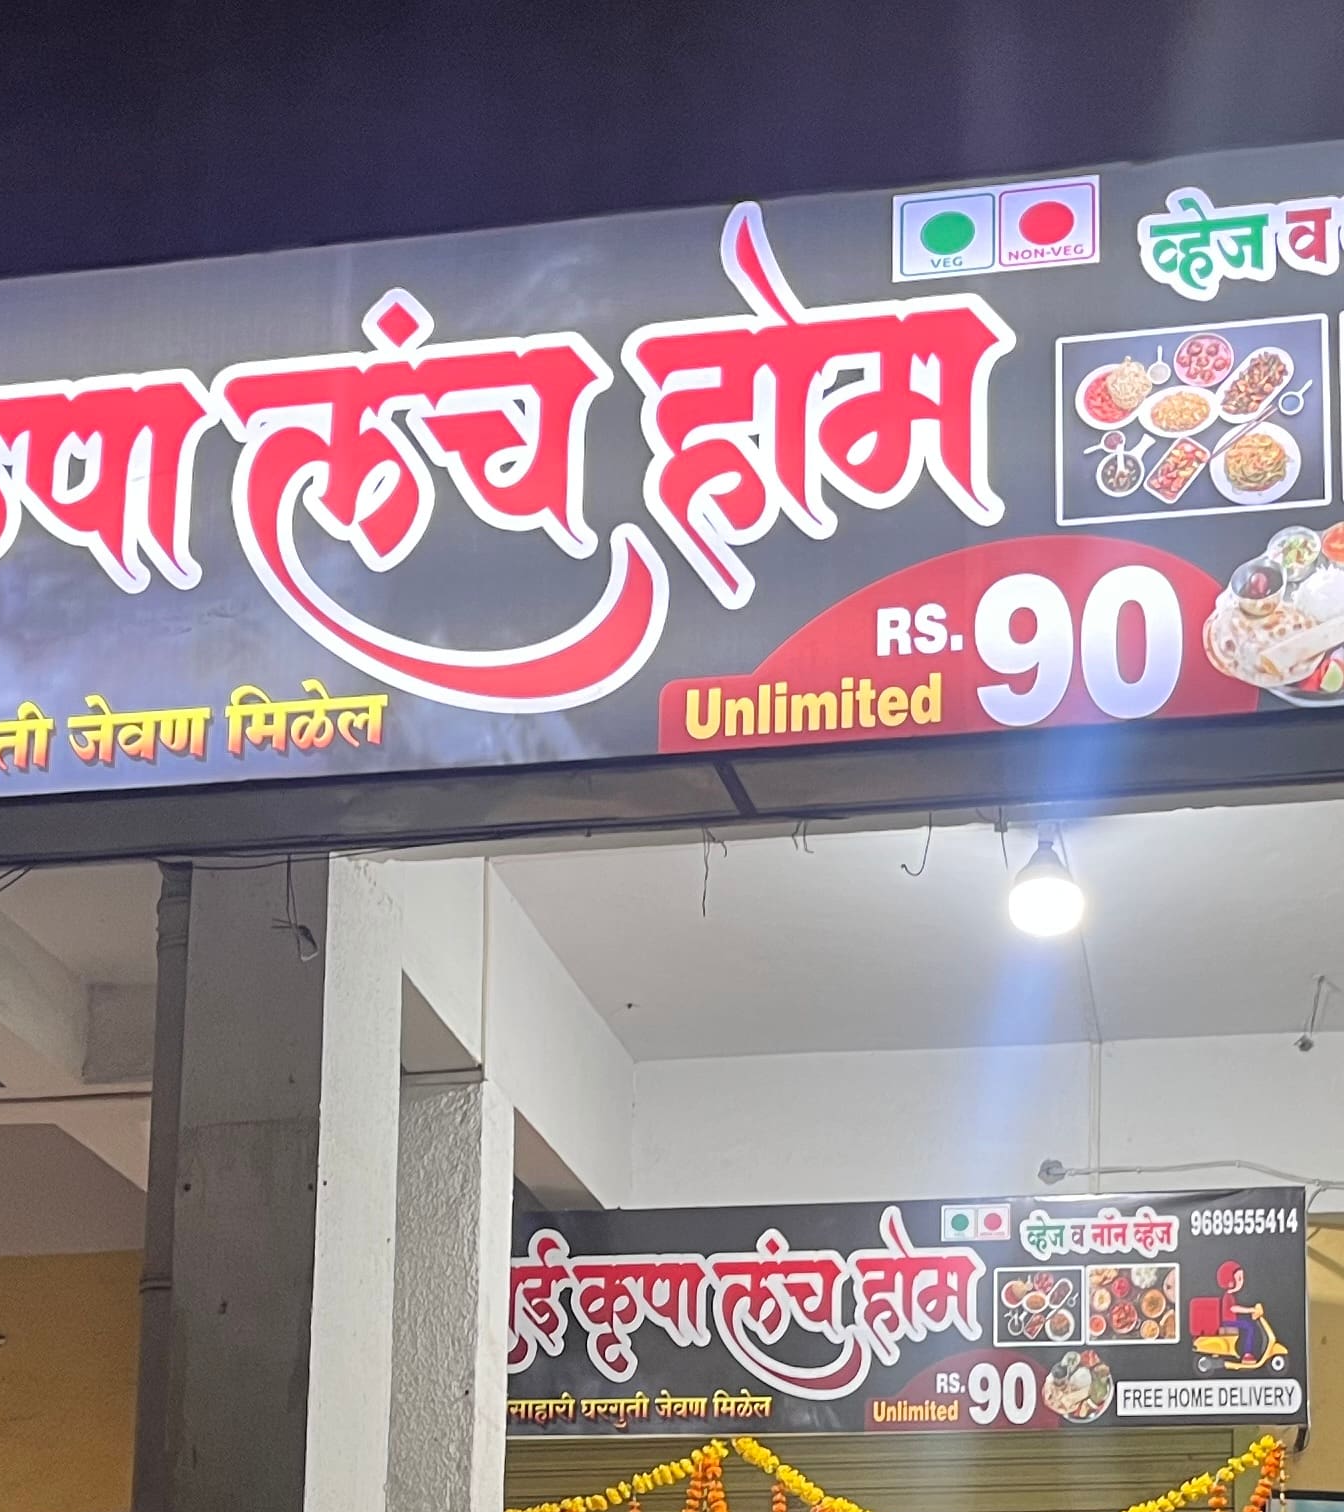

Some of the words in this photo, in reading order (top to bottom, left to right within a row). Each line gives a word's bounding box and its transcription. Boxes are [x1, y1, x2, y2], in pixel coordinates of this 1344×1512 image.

[929, 254, 964, 269] VEG
[1007, 243, 1086, 263] NON-VEG
[1144, 192, 1273, 296] व्हेज
[1286, 208, 1332, 263] व
[212, 288, 668, 713] लंच
[621, 200, 1017, 609] होम
[974, 563, 1184, 727] 90
[67, 694, 214, 765] जेवण
[224, 679, 390, 756] मिळेल
[684, 672, 943, 740] Unlimited
[1025, 1216, 1065, 1255] व्हेज
[1071, 1224, 1086, 1246] व
[1090, 1215, 1127, 1247] नॉन
[1133, 1212, 1173, 1252] व्हेज
[1190, 1208, 1299, 1237] 9689555414
[569, 1253, 711, 1383] कृपा
[708, 1228, 874, 1402] लंच
[847, 1204, 986, 1367] होम
[581, 1391, 650, 1429] घरगुती
[655, 1389, 707, 1419] जेवण
[712, 1388, 773, 1419] मिळेल
[873, 1400, 959, 1425] Unlimited
[968, 1361, 1037, 1425] 90
[1122, 1388, 1163, 1409] FREE
[1167, 1386, 1215, 1408] HOME
[1217, 1384, 1296, 1407] DELIVERY
